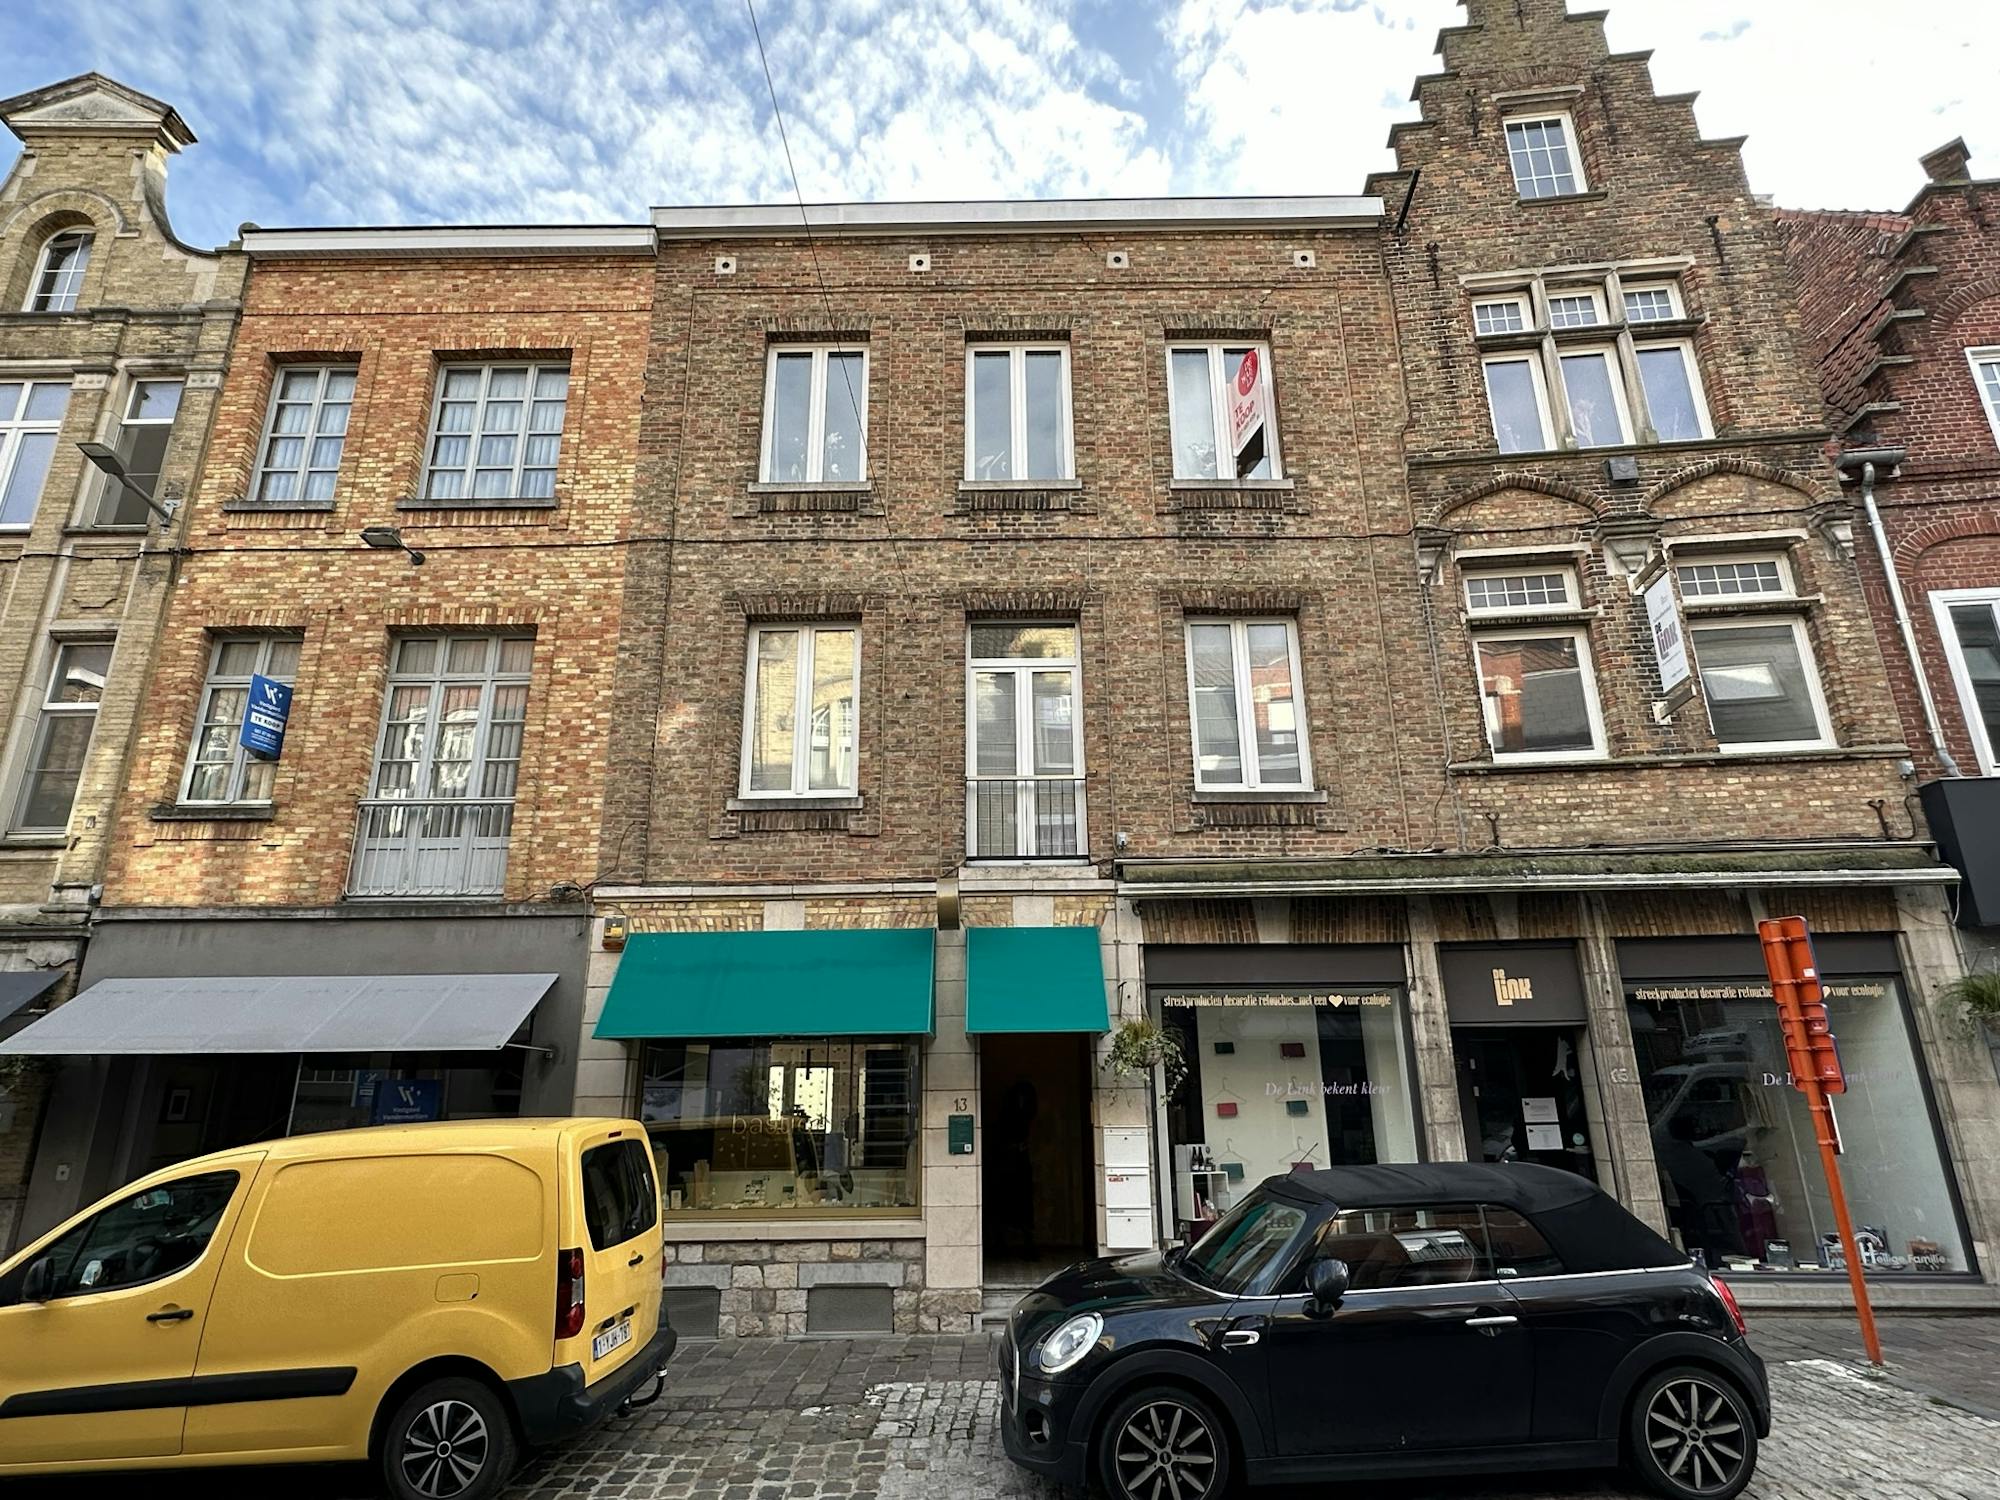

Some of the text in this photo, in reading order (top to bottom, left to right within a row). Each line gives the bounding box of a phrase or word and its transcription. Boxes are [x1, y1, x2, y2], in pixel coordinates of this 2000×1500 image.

[1235, 400, 1244, 418] TE
[1235, 400, 1255, 430] KOOP
[254, 715, 281, 729] TE KOOP
[1635, 986, 1699, 1002] streekproducten
[1700, 985, 1737, 999] decoratie
[1738, 985, 1774, 999] retouche
[1851, 982, 1885, 998] ecologie
[1163, 994, 1223, 1009] streekproducten
[1223, 993, 1258, 1007] decoratie
[1313, 995, 1328, 1006] een
[1343, 995, 1360, 1006] voor
[1361, 993, 1392, 1008] ecologie
[1762, 1072, 1782, 1086] De
[1265, 1079, 1392, 1096] De Link bekent kleur
[953, 1097, 967, 1112] 13
[1907, 1252, 1946, 1266] Familie
